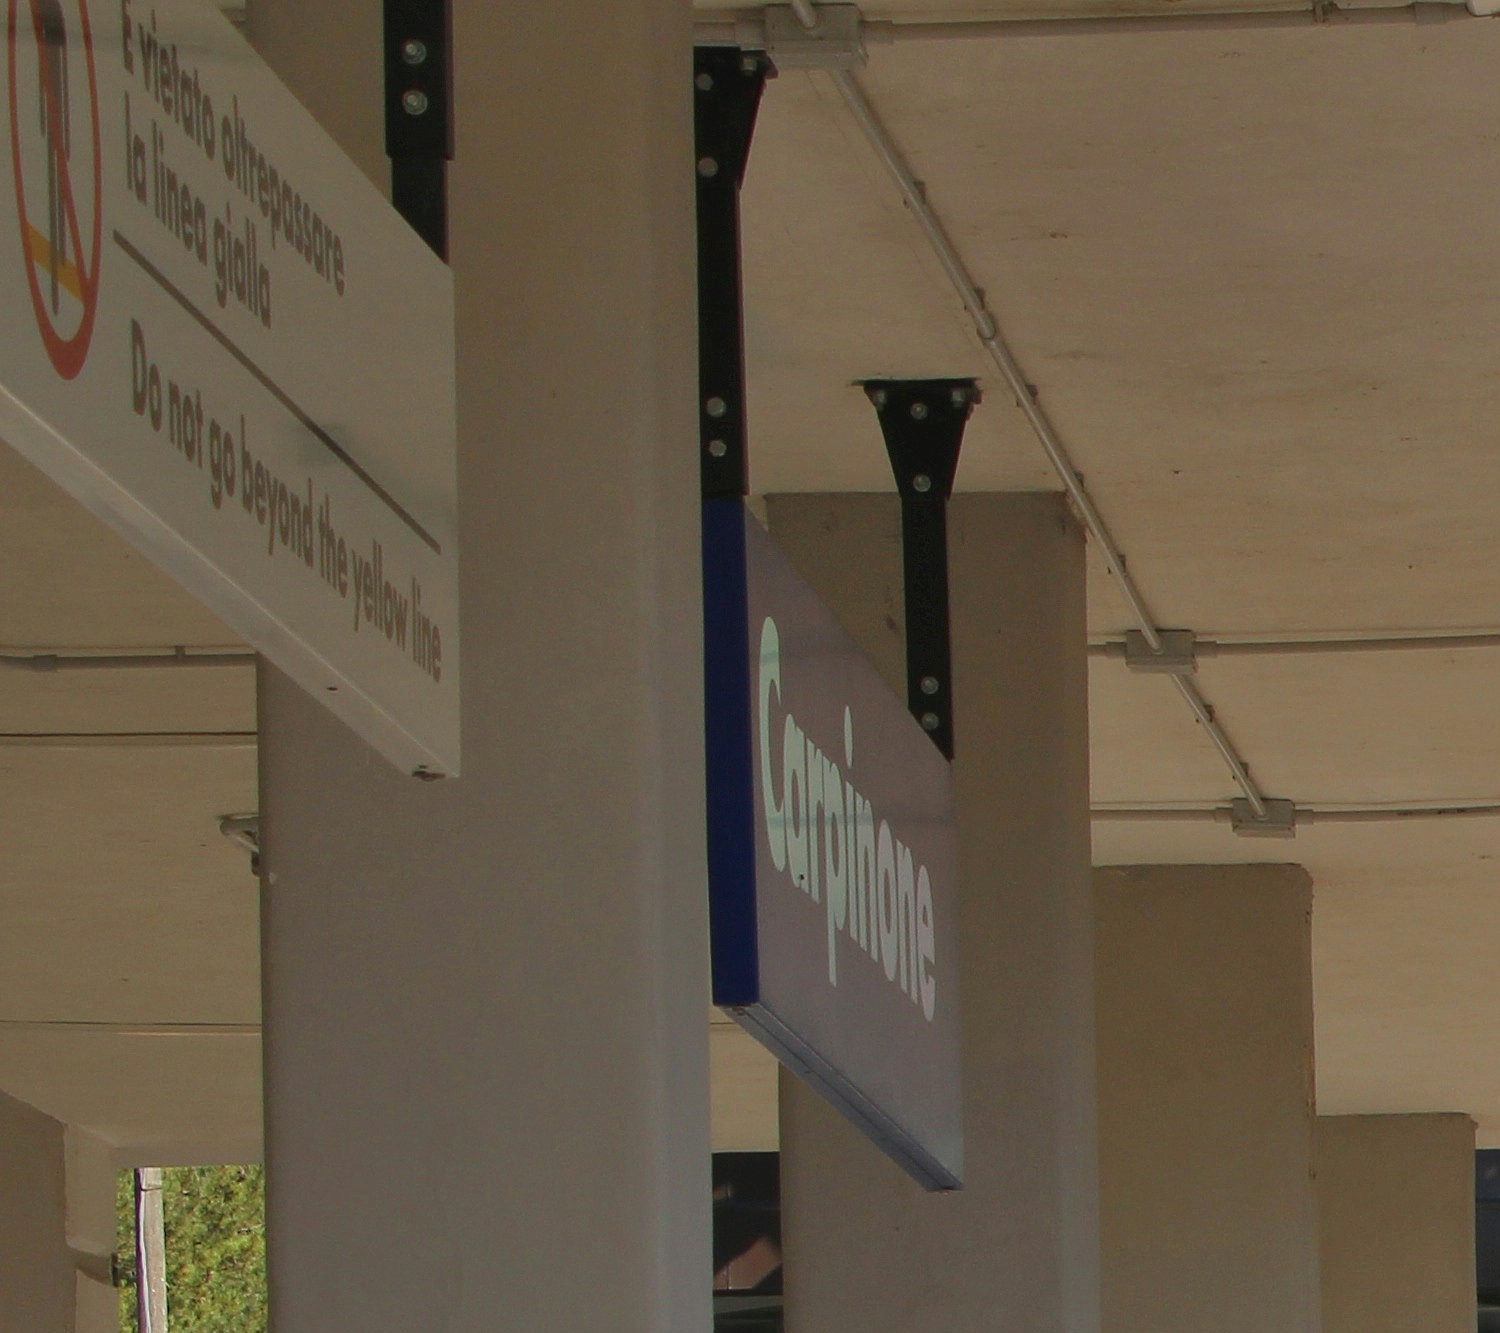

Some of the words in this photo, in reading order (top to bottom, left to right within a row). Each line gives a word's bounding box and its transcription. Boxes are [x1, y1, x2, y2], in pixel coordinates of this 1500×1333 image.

[125, 90, 147, 206] la
[152, 119, 207, 267] linea
[213, 201, 271, 329] gialla
[138, 9, 216, 161] vietato
[221, 94, 345, 297] oltrepassare
[131, 317, 163, 432] Do
[169, 379, 204, 469] not
[209, 417, 236, 510] go
[240, 413, 314, 568] beyond
[319, 493, 348, 599] the
[351, 538, 408, 652] yellow
[411, 575, 441, 682] line
[759, 616, 936, 1023] Carpinone
